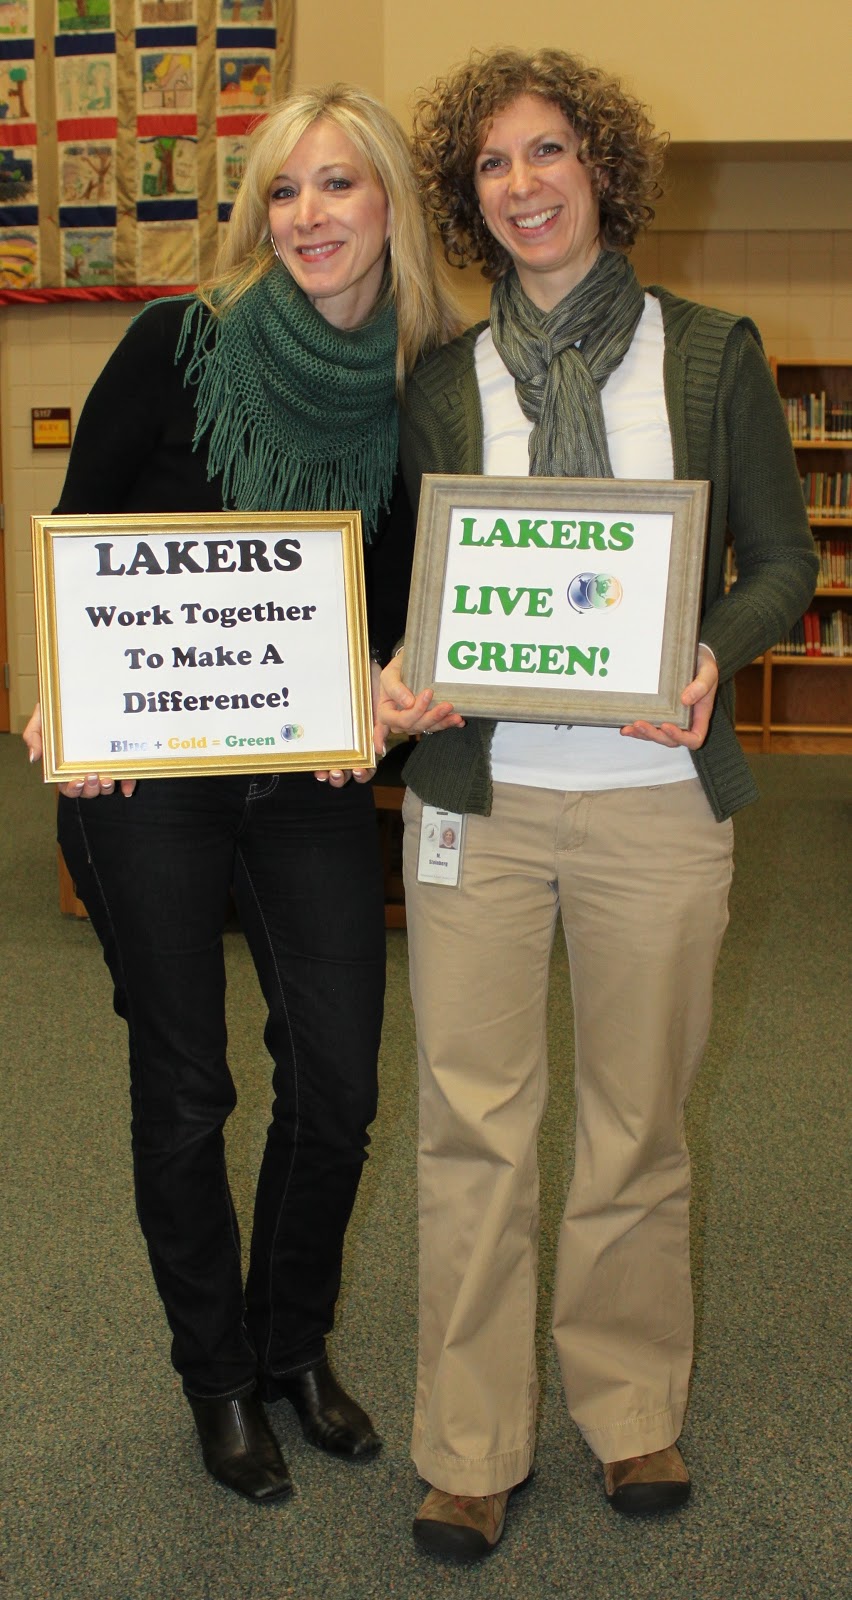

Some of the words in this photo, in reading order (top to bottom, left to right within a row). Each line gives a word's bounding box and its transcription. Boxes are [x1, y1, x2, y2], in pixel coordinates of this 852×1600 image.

[459, 517, 634, 551] LAKERS
[95, 539, 302, 576] LAKERS
[85, 605, 173, 627] Work
[181, 601, 317, 627] Together
[452, 585, 553, 618] LIVE
[124, 648, 164, 670] To
[172, 645, 252, 668] Make
[260, 644, 284, 665] A
[447, 641, 610, 677] GREEN!
[123, 687, 289, 714] Difference!
[110, 740, 148, 752] Blue
[168, 736, 207, 750] Gold
[225, 734, 275, 747] Green
